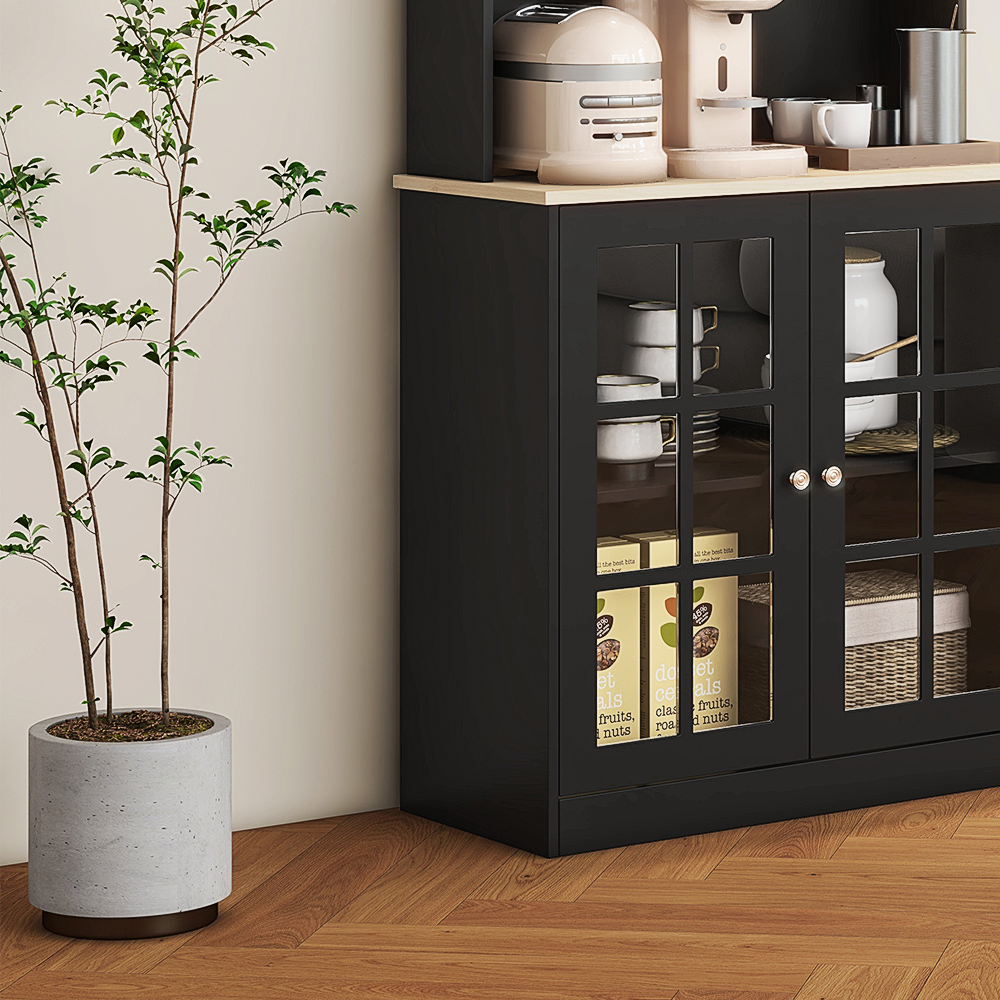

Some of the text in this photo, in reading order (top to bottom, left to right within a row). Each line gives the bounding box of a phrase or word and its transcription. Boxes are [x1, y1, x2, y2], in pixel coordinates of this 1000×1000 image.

[698, 697, 734, 711] fruits,
[598, 711, 635, 725] fruits,
[702, 711, 730, 724] nuts
[603, 725, 631, 738] nuts
